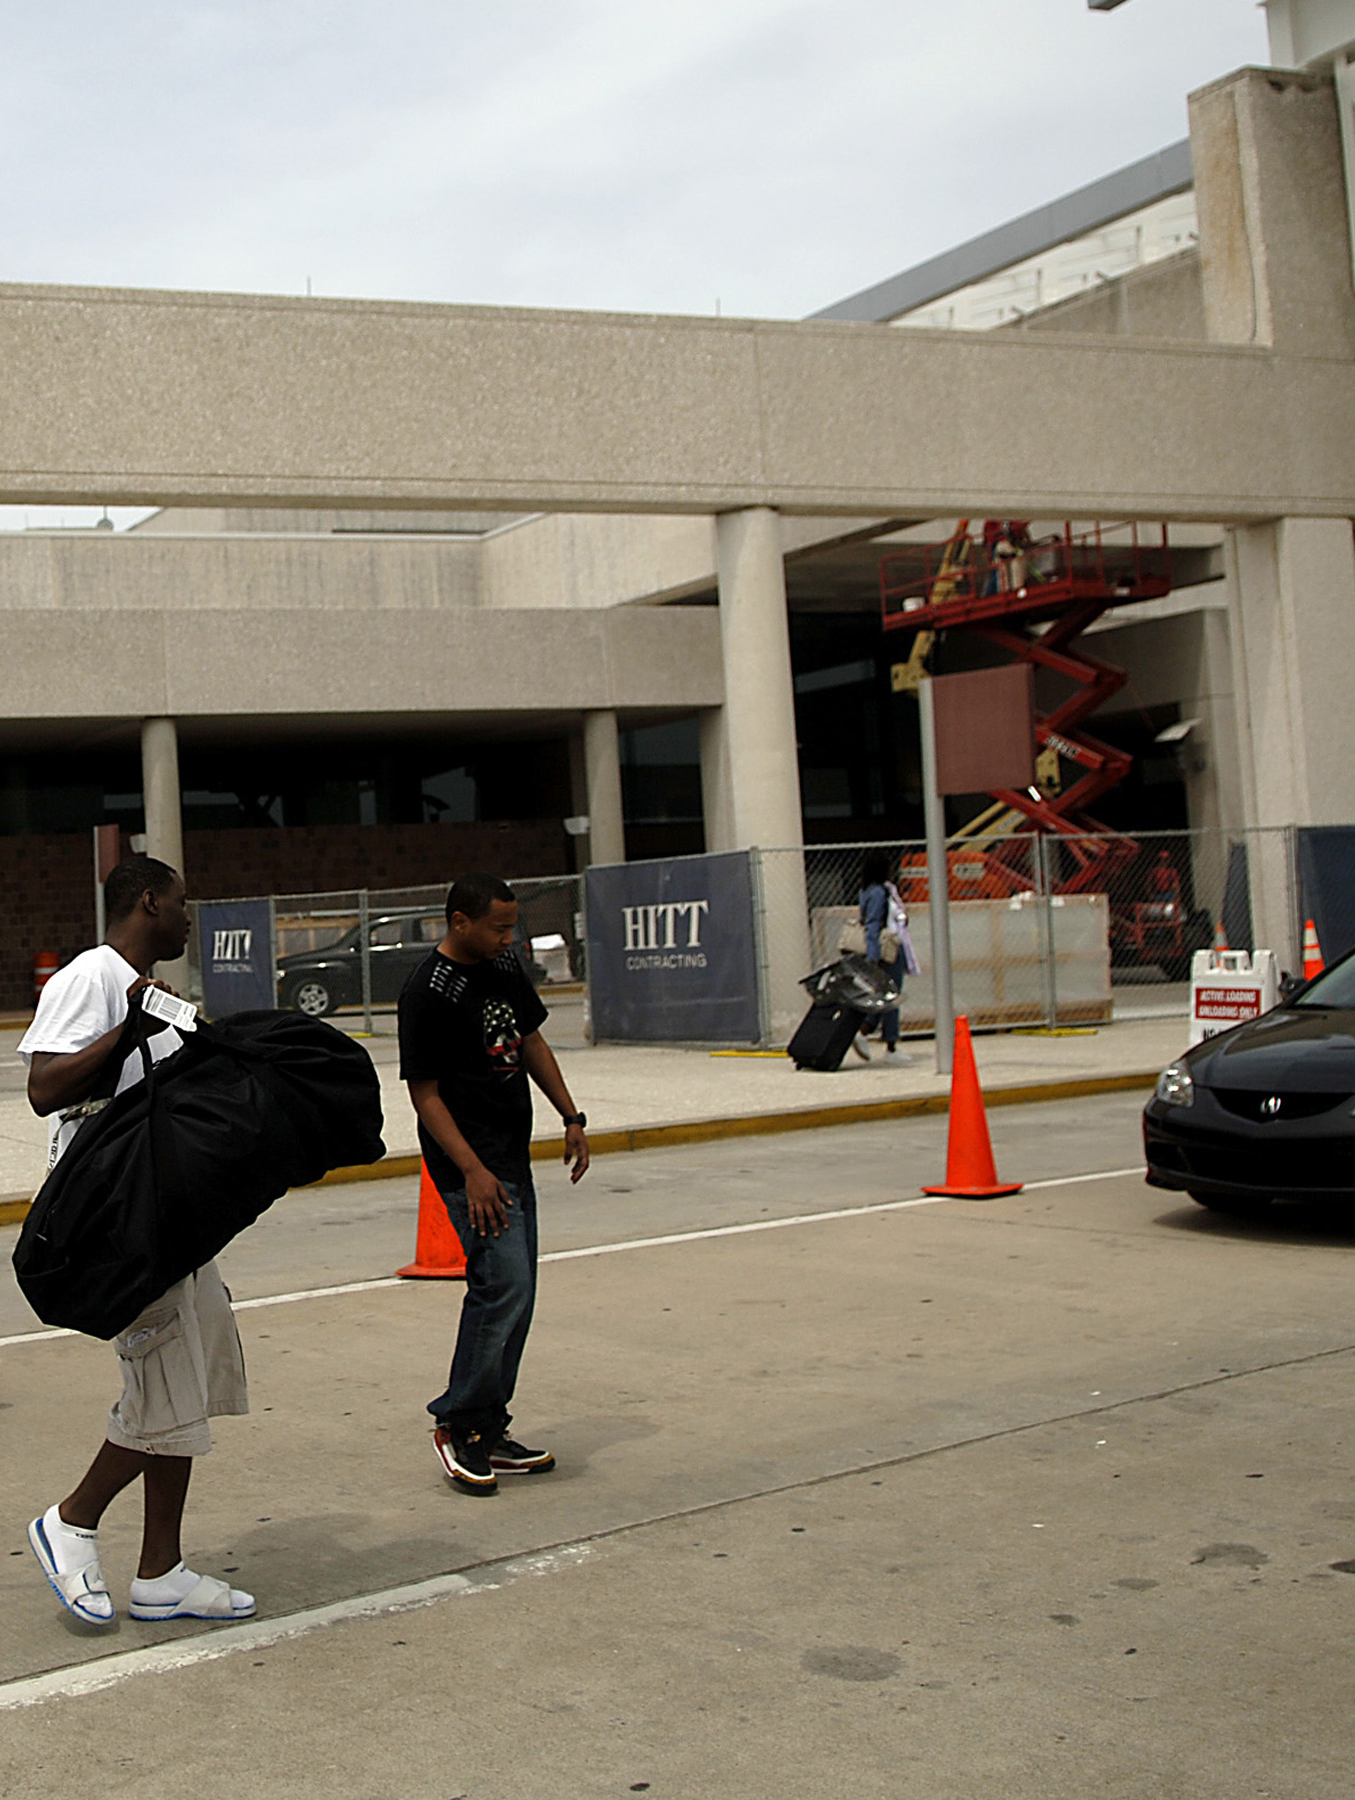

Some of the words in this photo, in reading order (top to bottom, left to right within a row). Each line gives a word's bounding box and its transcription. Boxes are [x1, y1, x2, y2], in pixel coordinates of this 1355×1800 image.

[622, 900, 709, 951] HITT
[626, 953, 708, 970] CONTRACTING
[1226, 991, 1256, 1003] LOADING
[1198, 1005, 1238, 1018] UNLOADING
